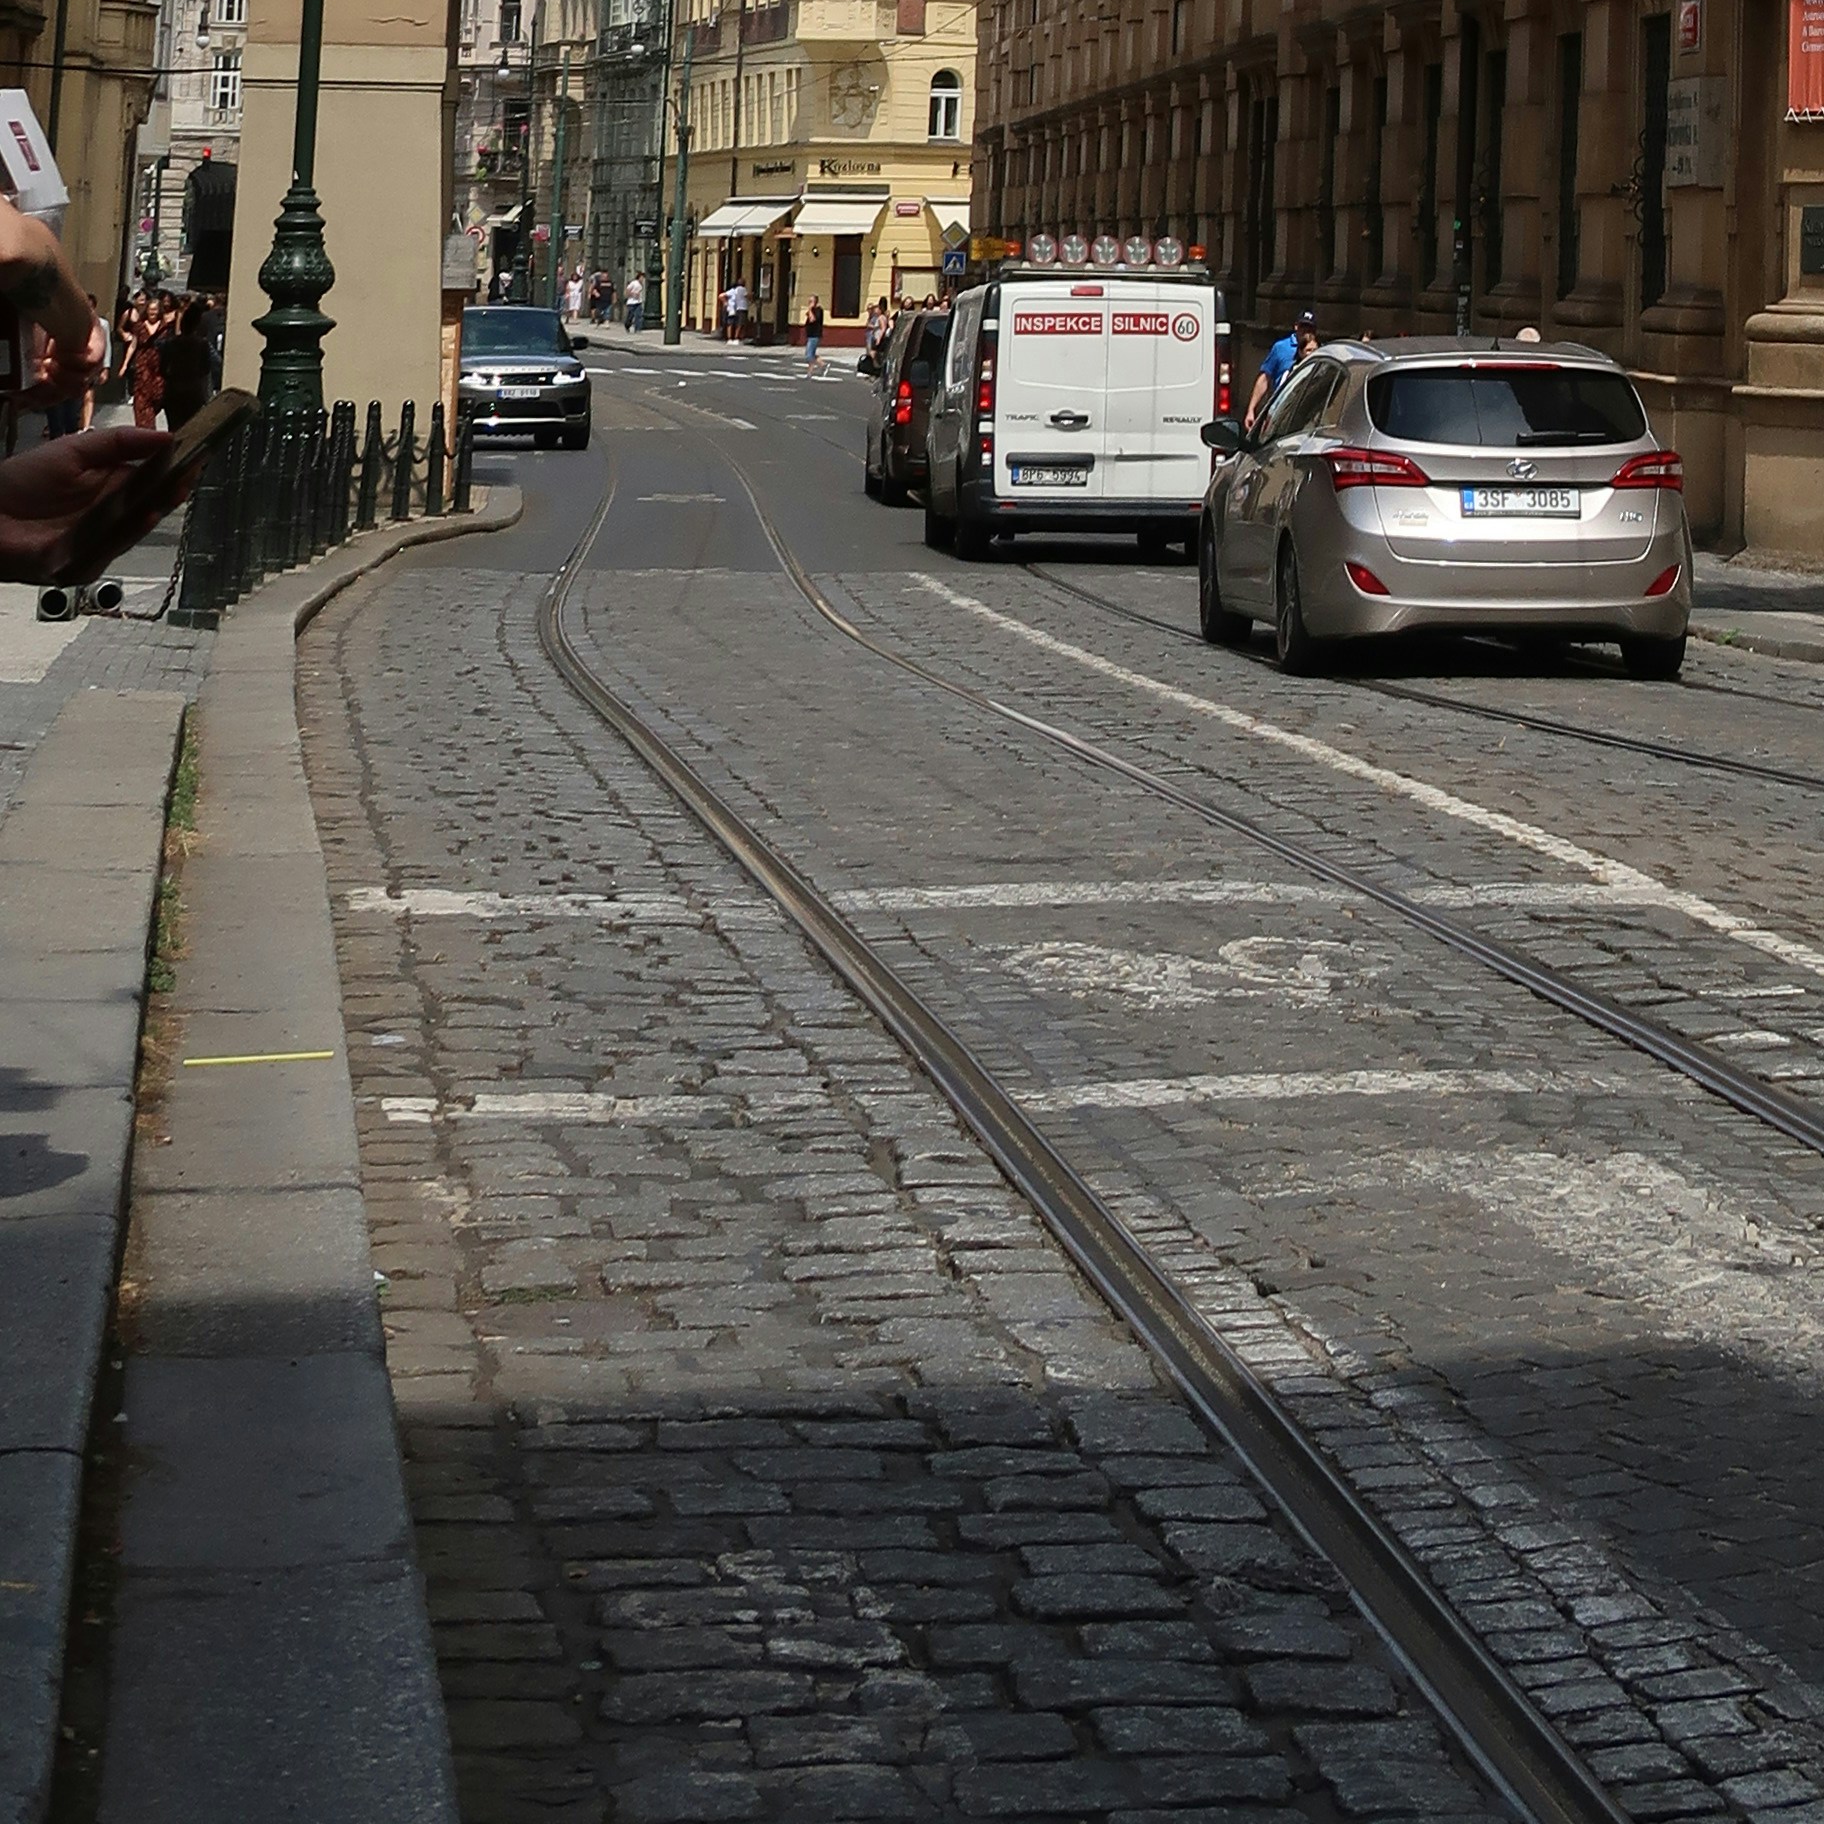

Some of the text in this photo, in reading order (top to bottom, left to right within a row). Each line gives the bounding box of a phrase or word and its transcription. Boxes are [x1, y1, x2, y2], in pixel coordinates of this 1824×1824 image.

[1015, 316, 1168, 331] INSPEKCE SILNIC
[1177, 319, 1195, 335] 60
[1478, 490, 1511, 508] 3SF
[1526, 490, 1571, 508] 3085
